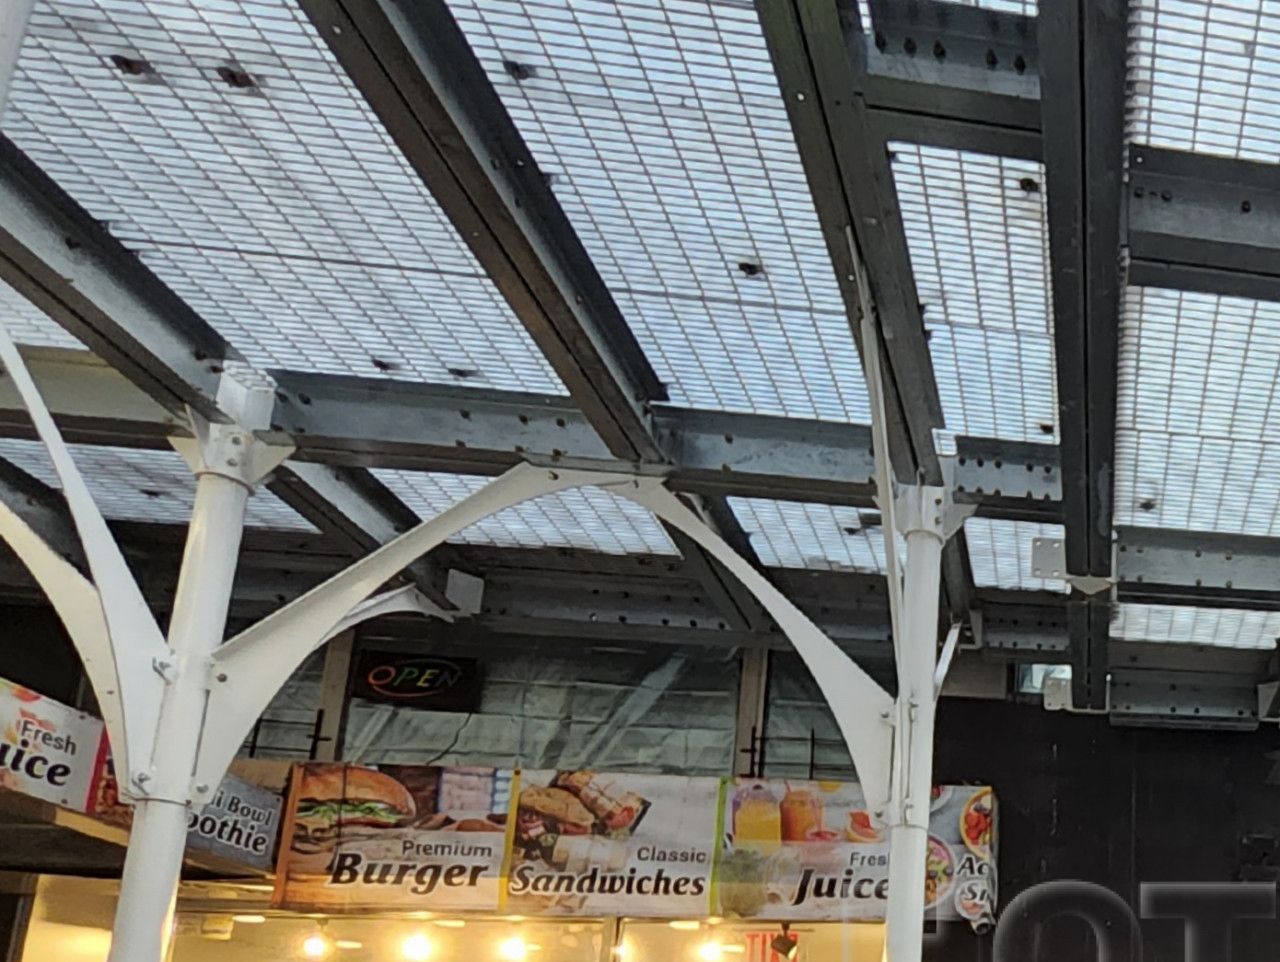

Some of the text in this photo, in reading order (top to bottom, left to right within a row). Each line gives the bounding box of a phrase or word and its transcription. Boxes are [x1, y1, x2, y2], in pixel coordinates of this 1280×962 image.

[367, 664, 460, 689] OPEN
[21, 720, 77, 755] Fresh
[227, 795, 272, 826] Bowl
[188, 813, 267, 852] oothie
[402, 840, 492, 858] Premium
[637, 846, 707, 864] Classic
[850, 851, 889, 867] Fres
[331, 852, 489, 893] Burger
[510, 865, 705, 897] Sandwiches
[791, 868, 889, 906] Juice
